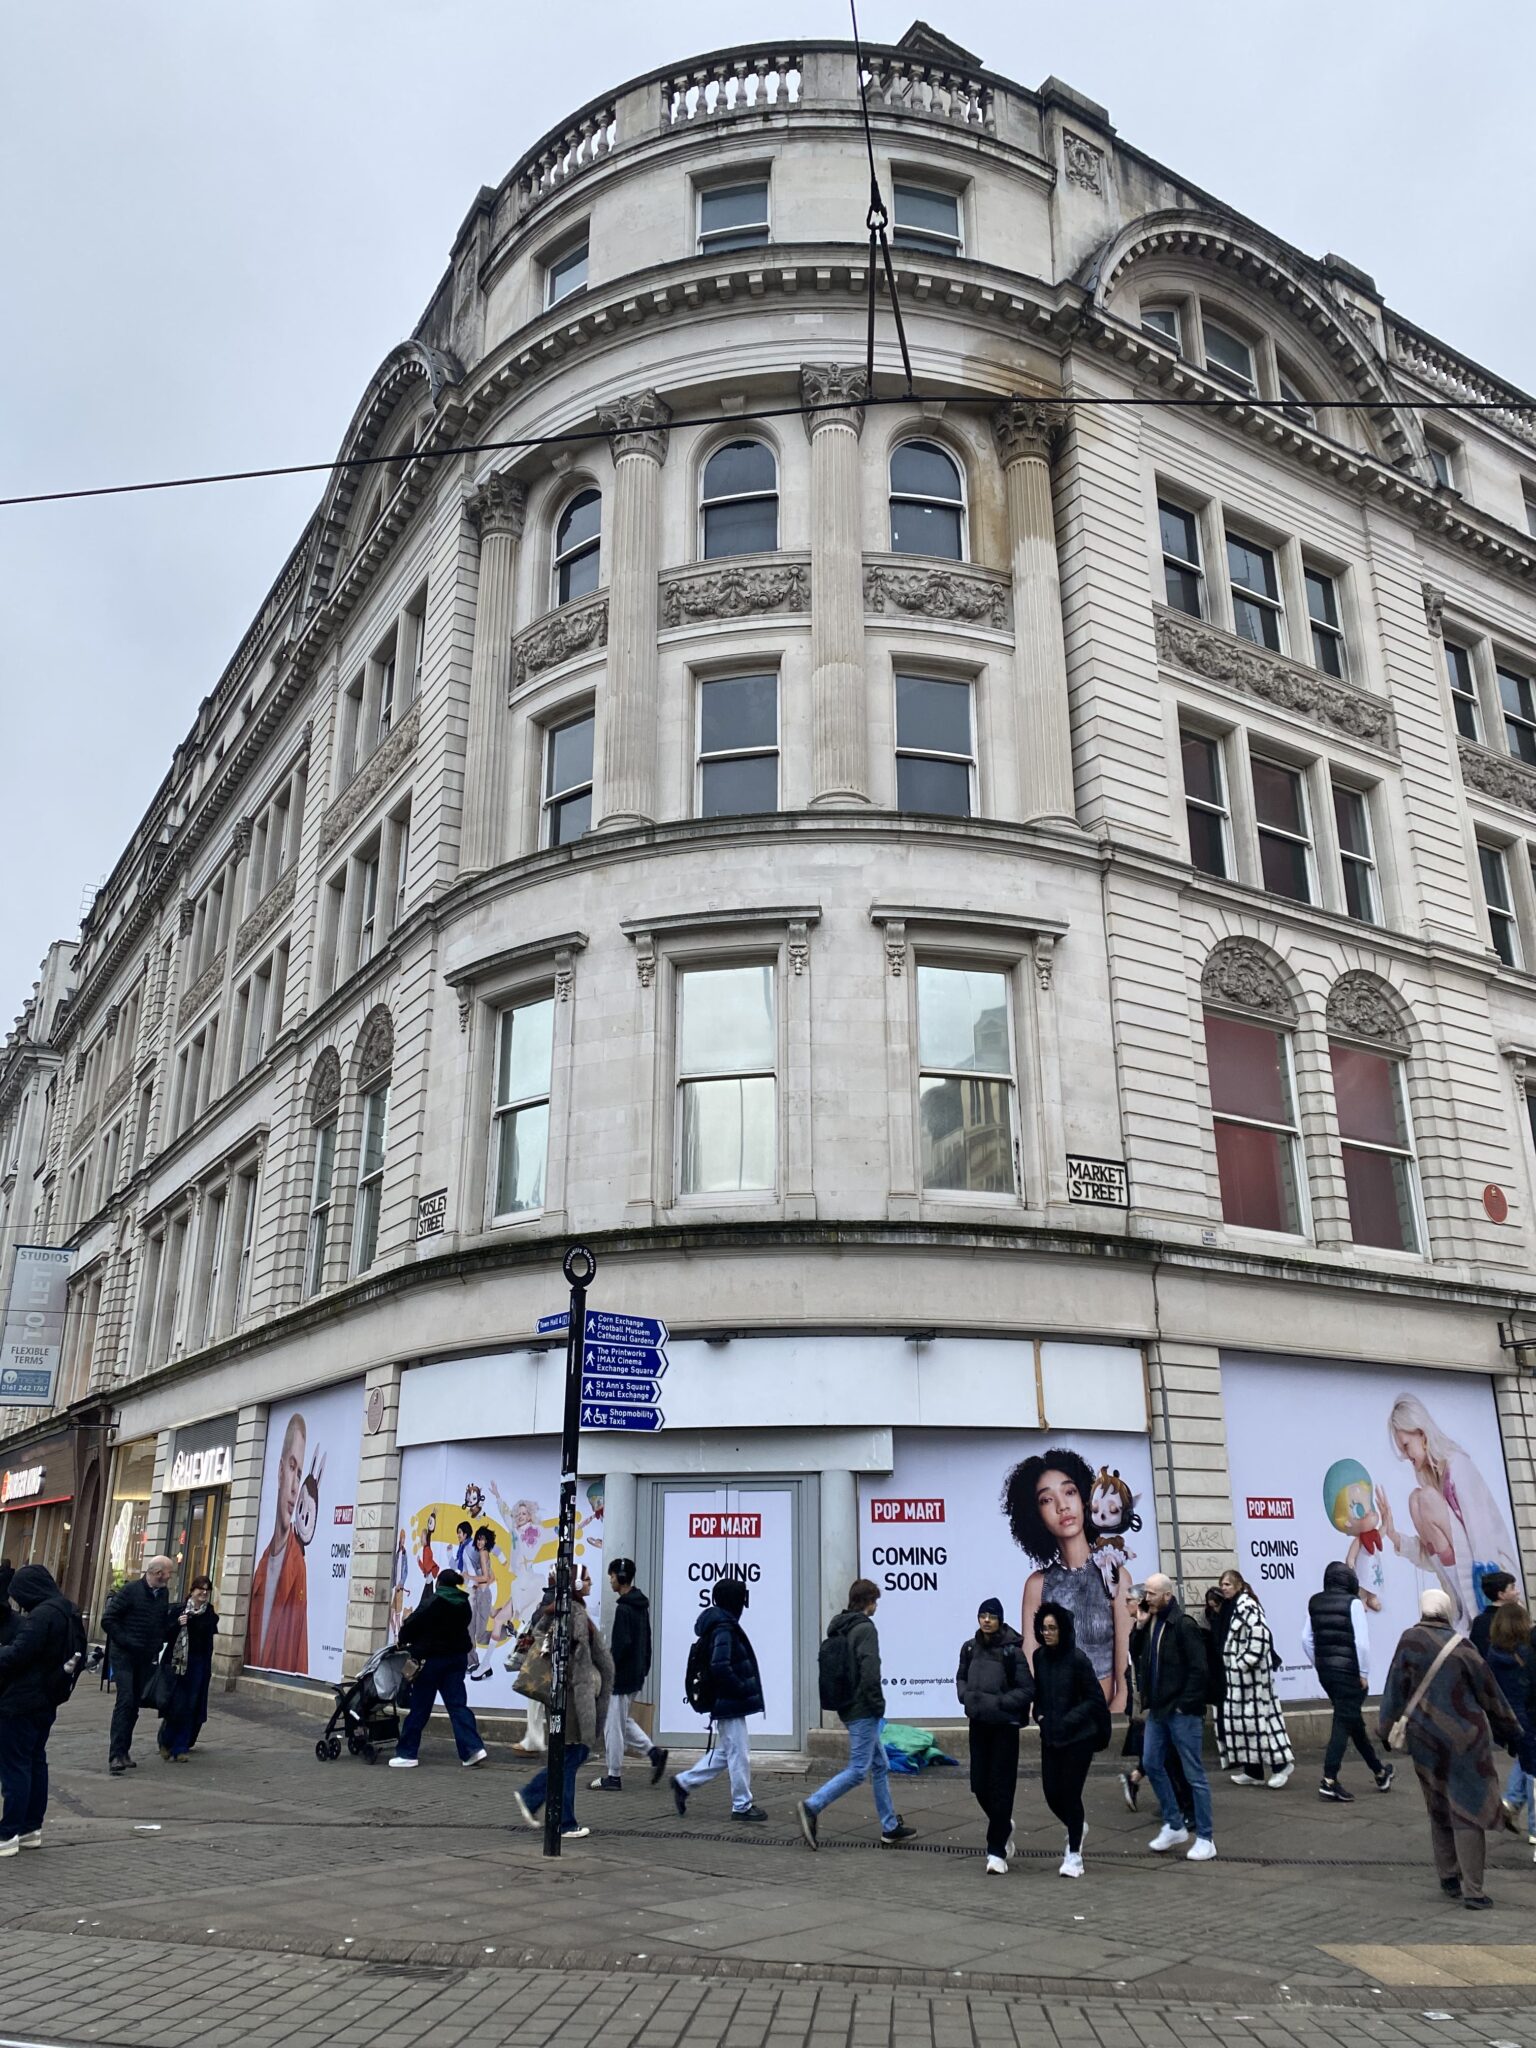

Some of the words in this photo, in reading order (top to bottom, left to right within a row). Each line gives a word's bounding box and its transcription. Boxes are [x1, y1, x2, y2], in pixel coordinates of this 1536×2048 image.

[1068, 1161, 1125, 1185] MARKET
[1072, 1180, 1124, 1203] STREET
[419, 1195, 447, 1219] MOSLEY
[419, 1212, 445, 1236] STREET
[20, 1251, 70, 1263] STUDIOS
[597, 1314, 614, 1323] Corn
[615, 1316, 644, 1328] Exchange
[597, 1322, 624, 1333] Football
[596, 1331, 628, 1342] Cathedral
[629, 1335, 655, 1345] Gardens
[11, 1346, 50, 1356] FLEXIBLE
[597, 1346, 609, 1355] The
[611, 1347, 646, 1358] Printworks
[14, 1355, 44, 1365] TERMS
[597, 1355, 616, 1363] IMAX
[617, 1356, 642, 1366] Cinema
[596, 1363, 629, 1374] Exchange
[630, 1365, 654, 1375] Square
[596, 1380, 605, 1389] St
[605, 1381, 624, 1390] Ann's
[626, 1382, 651, 1391] Square
[596, 1389, 615, 1398] Royal
[617, 1390, 650, 1400] Exchange
[609, 1408, 654, 1420] Shopmobility
[609, 1416, 626, 1426] Taxis
[184, 1446, 231, 1487] HEYTEA
[874, 1502, 901, 1520] POP
[904, 1502, 942, 1520] MART
[1248, 1501, 1266, 1517] POP
[1267, 1501, 1292, 1517] MART
[692, 1517, 717, 1535] POP
[720, 1517, 758, 1535] MART
[331, 1543, 351, 1558] COMING
[872, 1546, 948, 1566] COMING
[1250, 1540, 1299, 1557] COMING
[332, 1563, 346, 1578] SOON
[688, 1562, 761, 1582] COMING
[1260, 1563, 1295, 1580] SOON
[884, 1572, 938, 1591] SOON
